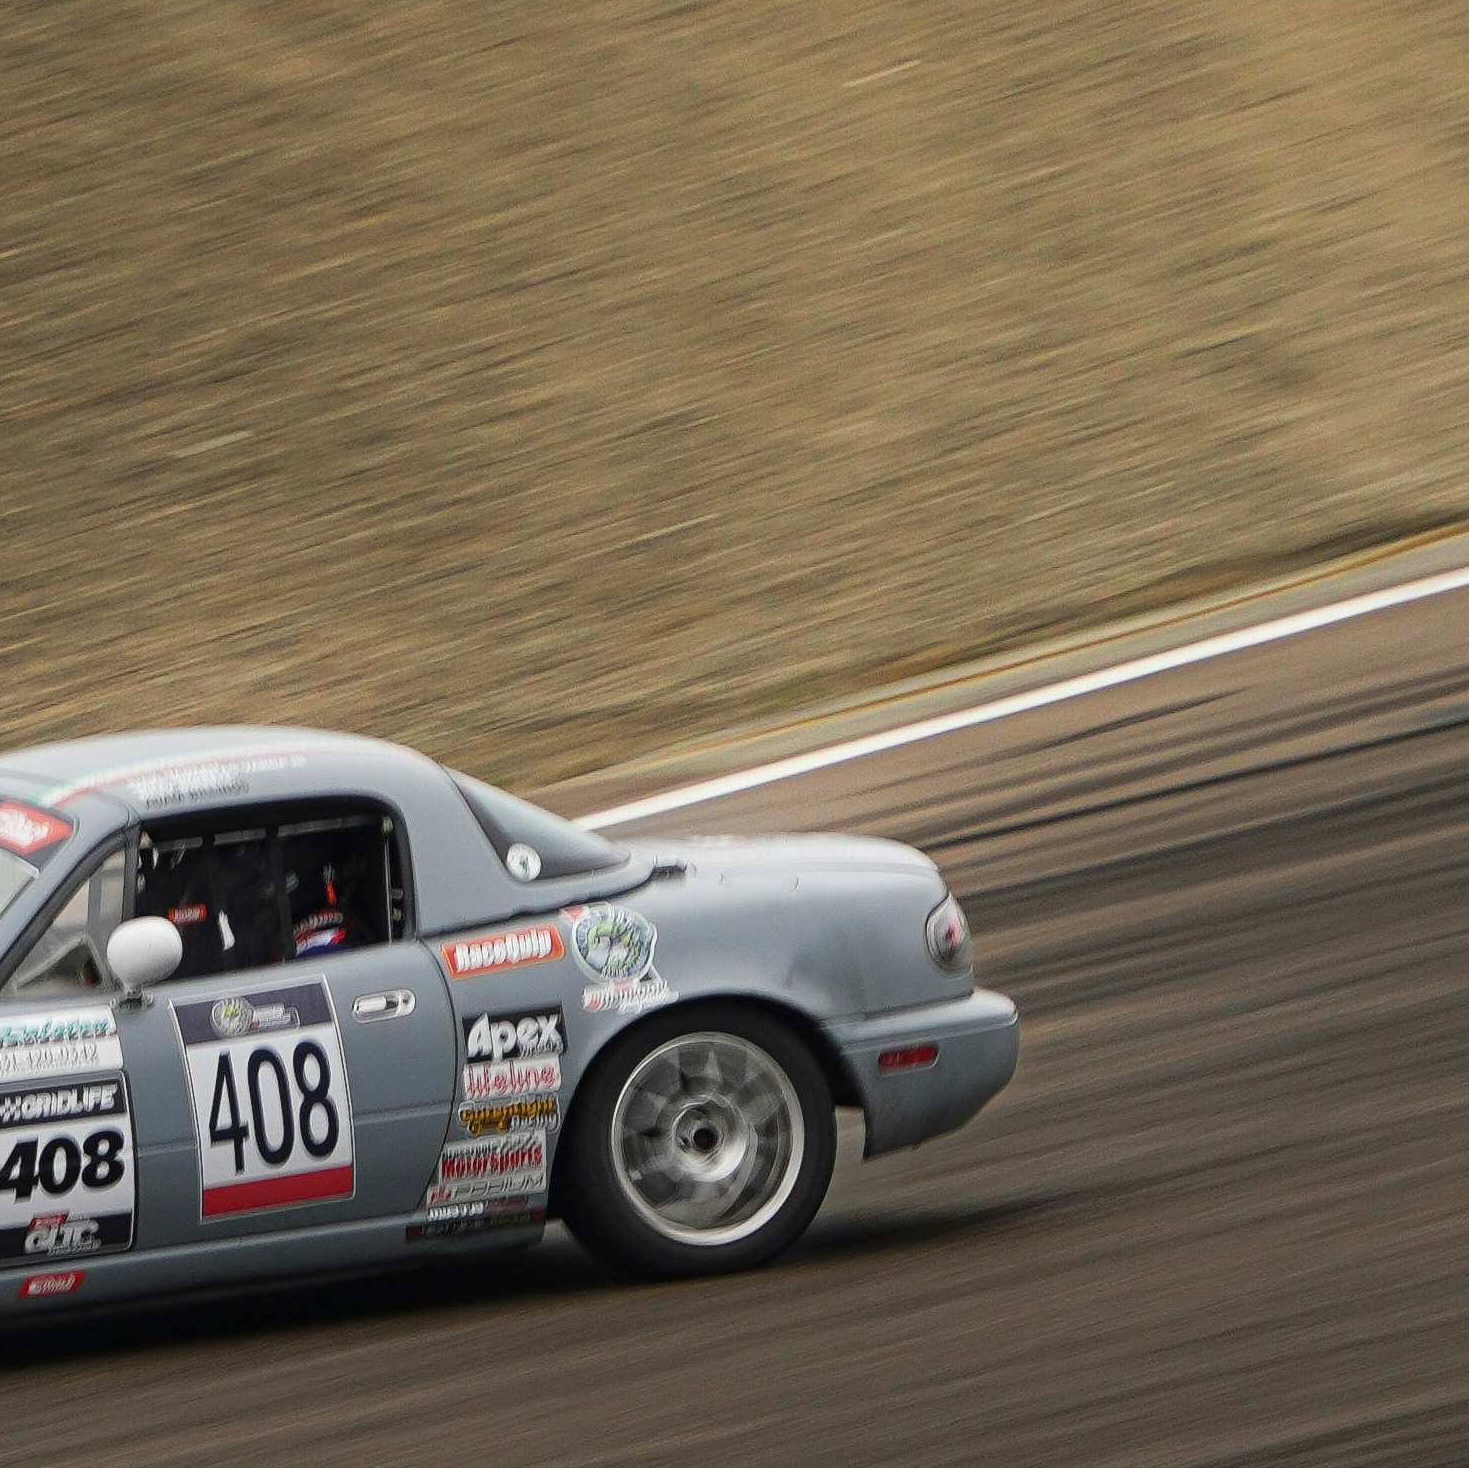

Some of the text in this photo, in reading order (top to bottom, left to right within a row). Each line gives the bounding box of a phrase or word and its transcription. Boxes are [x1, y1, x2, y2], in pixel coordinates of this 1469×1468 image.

[467, 1013, 562, 1062] Apex
[21, 1083, 118, 1121] GRIDLIFE
[208, 1041, 340, 1174] 408
